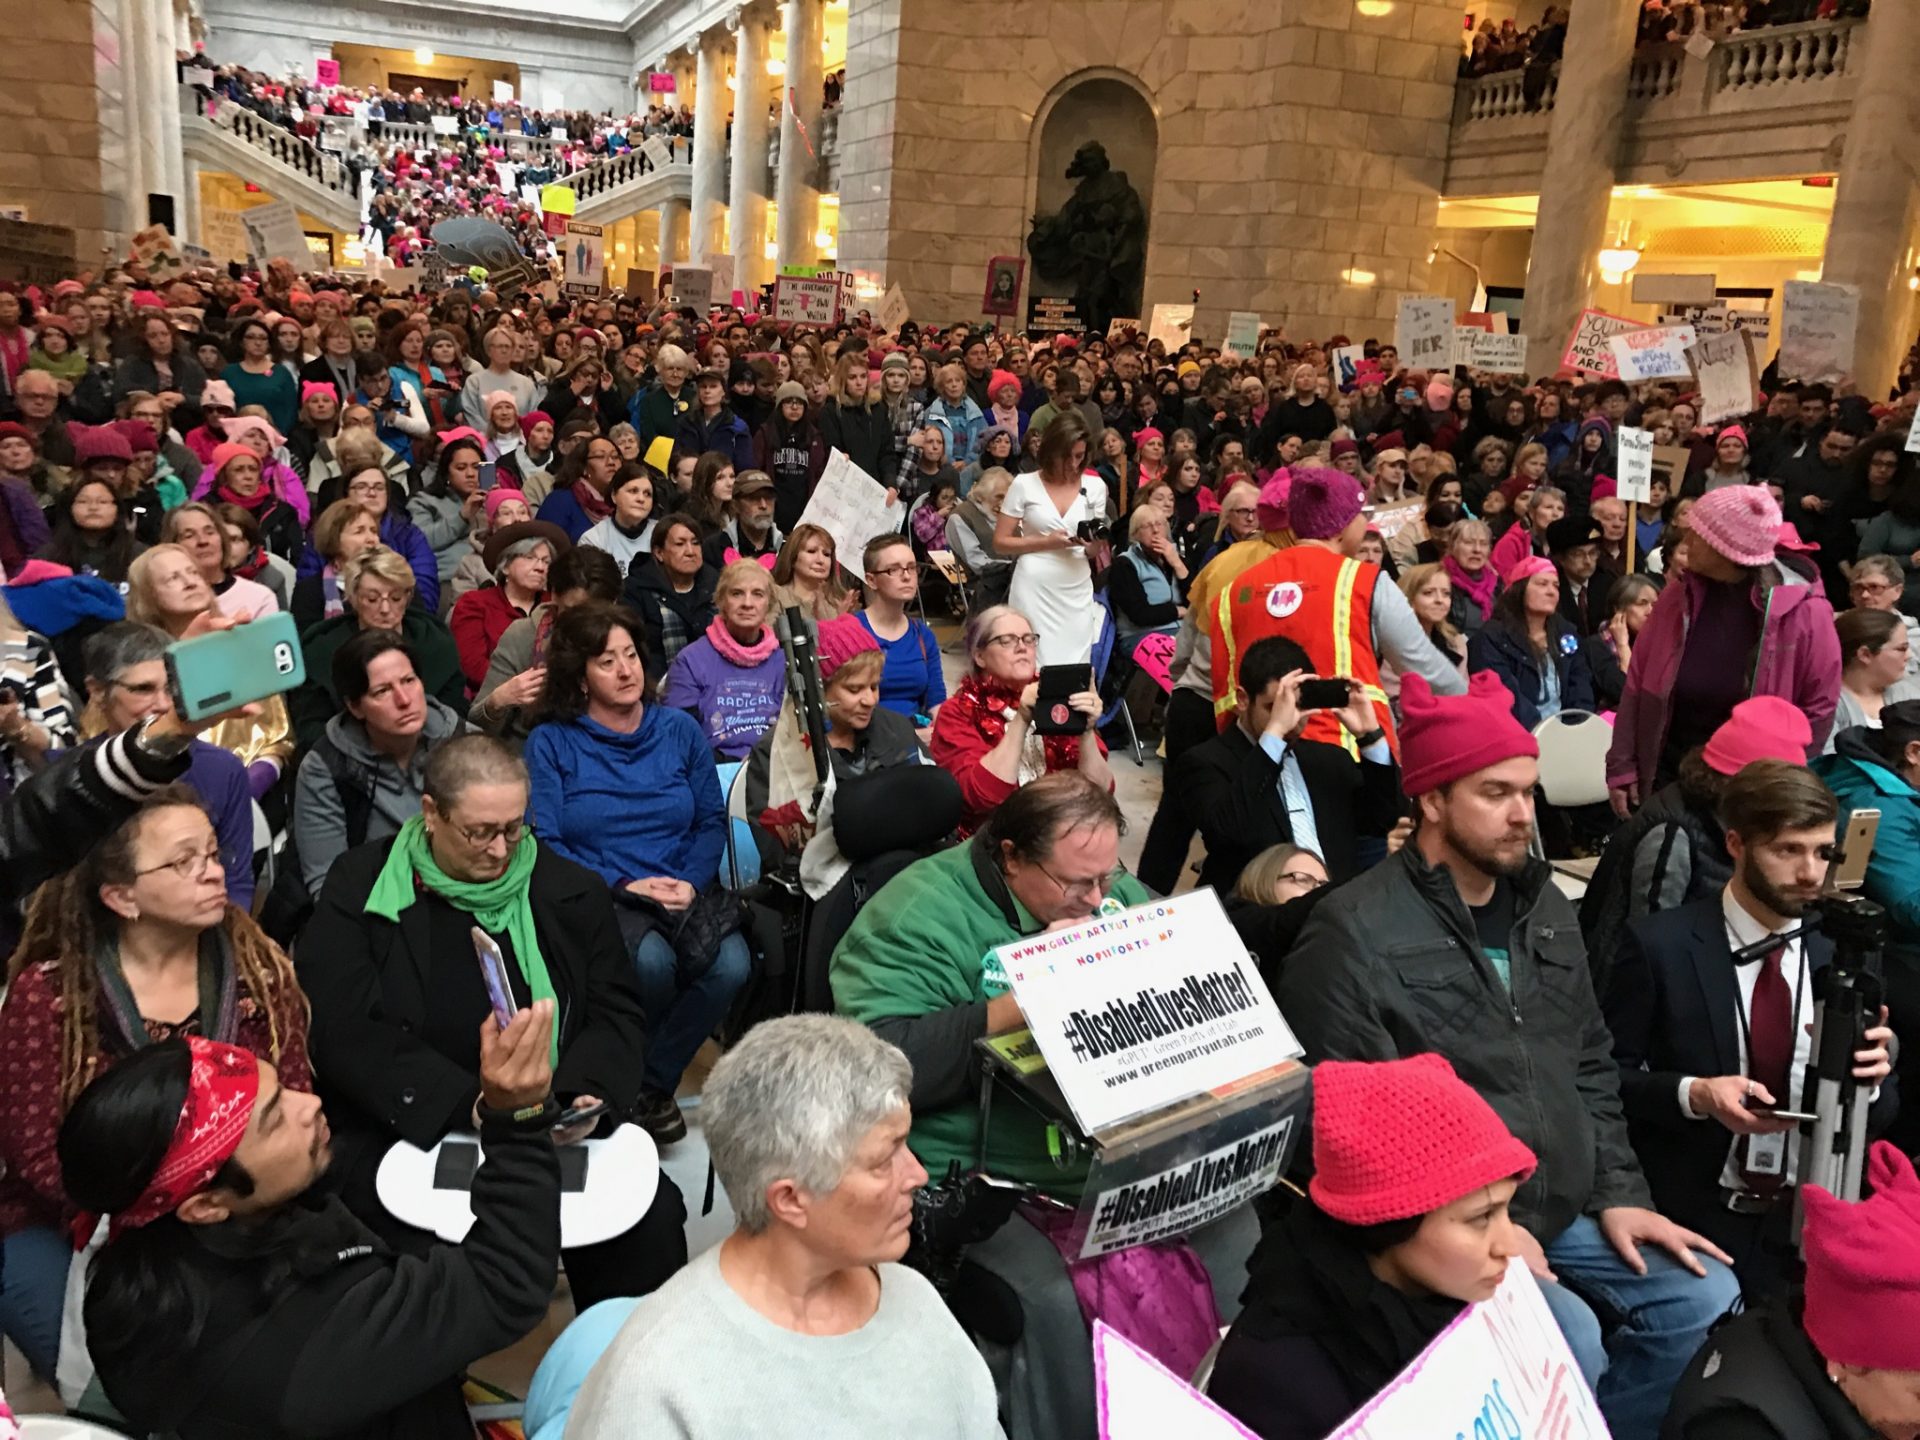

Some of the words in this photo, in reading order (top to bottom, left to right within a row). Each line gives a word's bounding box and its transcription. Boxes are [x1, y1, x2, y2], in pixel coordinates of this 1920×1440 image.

[837, 271, 854, 288] TO
[782, 309, 795, 318] MY
[1228, 342, 1255, 352] TRUTH
[1412, 335, 1443, 357] HER
[1571, 345, 1595, 356] AND
[1577, 359, 1604, 371] ARE
[716, 695, 775, 708] RADICAL
[725, 715, 767, 726] Women
[1010, 906, 1175, 961] WWW.GREENARTYUTH.COM
[1062, 962, 1260, 1065] #DisabledLivesMatter!
[1153, 1036, 1181, 1055] Green
[1095, 1119, 1291, 1233] #DisabledLivesMatter!
[1102, 1181, 1267, 1252] www.greenpartyutah.com
[1168, 1205, 1196, 1223] Green
